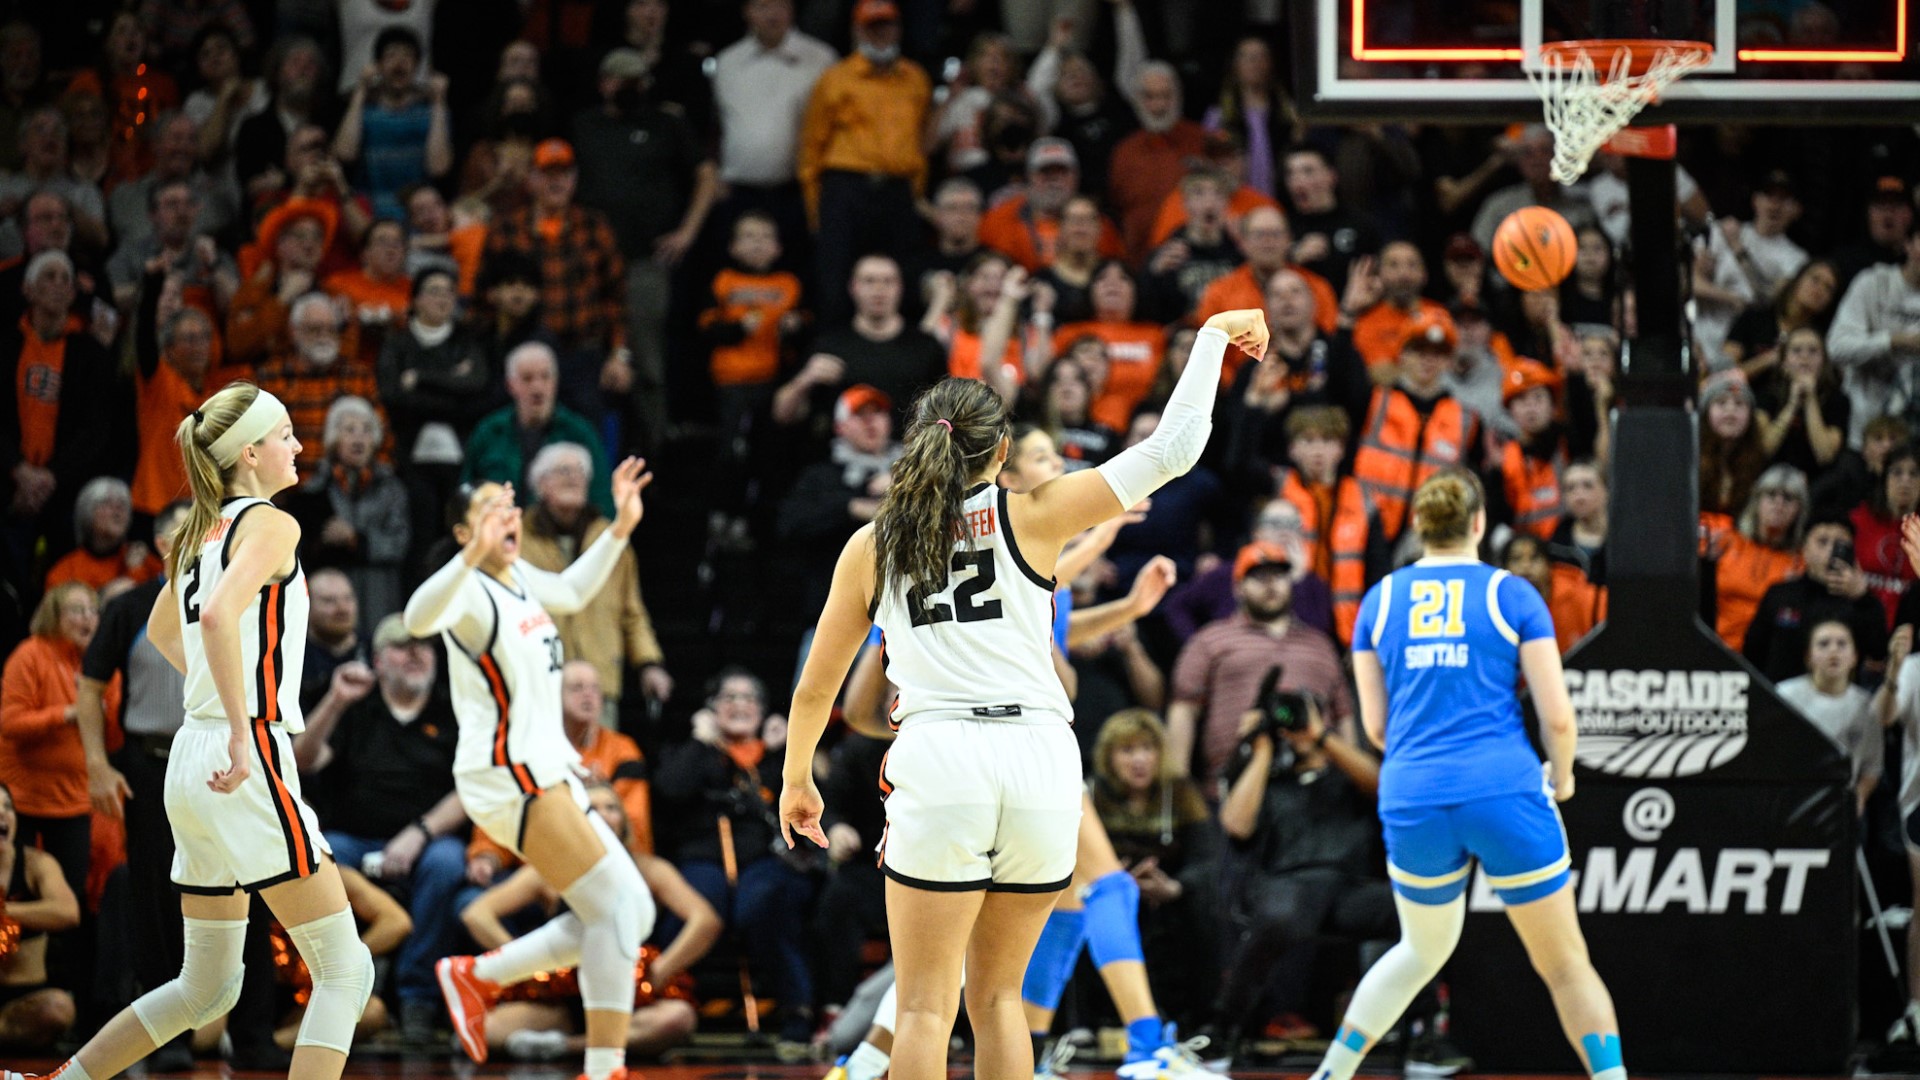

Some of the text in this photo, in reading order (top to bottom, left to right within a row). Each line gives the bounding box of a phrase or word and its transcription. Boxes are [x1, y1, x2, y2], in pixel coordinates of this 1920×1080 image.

[183, 553, 202, 624] 2
[906, 547, 1003, 629] 22
[1408, 579, 1466, 639] 21
[1405, 643, 1469, 670] SONTAG
[1563, 669, 1750, 711] CASCADE
[1635, 711, 1749, 733] OUTDOOR
[1622, 787, 1676, 842] @
[1469, 847, 1831, 914] -MART
